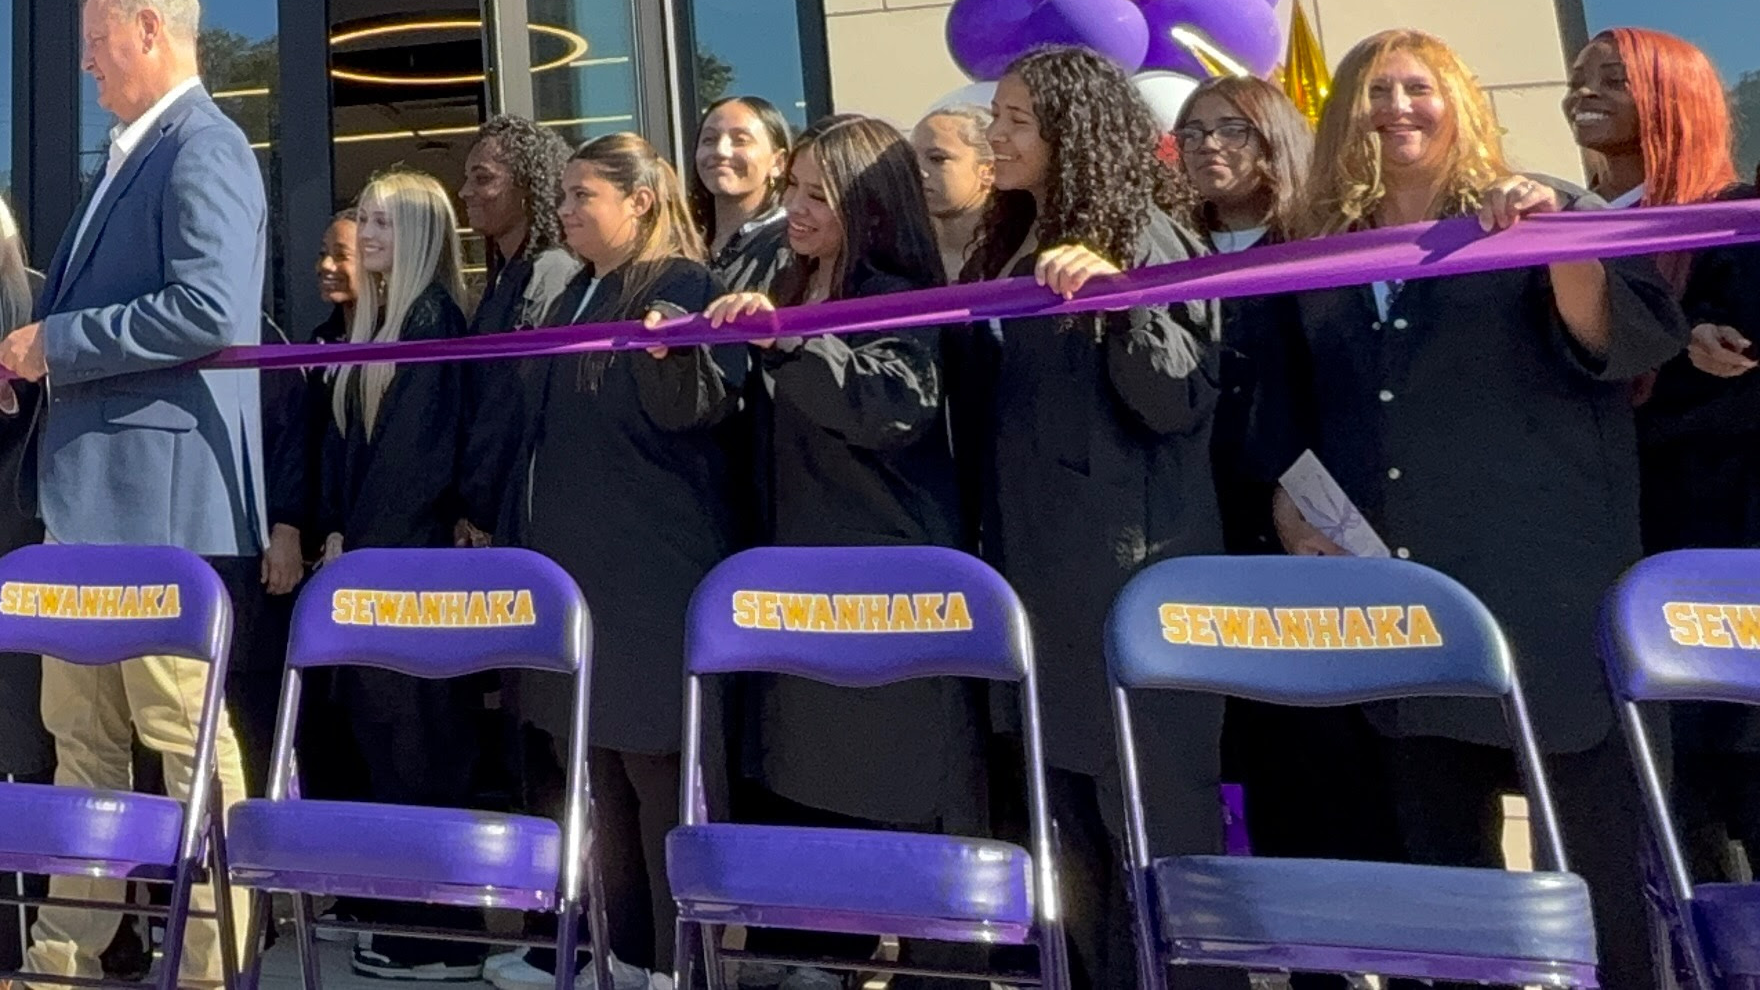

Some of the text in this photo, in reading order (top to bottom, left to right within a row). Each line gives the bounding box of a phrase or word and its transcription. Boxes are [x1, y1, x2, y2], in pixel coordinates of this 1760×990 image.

[331, 589, 536, 628] SEWANHAKA
[732, 590, 973, 633] SEWANHAKA
[1158, 603, 1443, 650] SEWANHAKA
